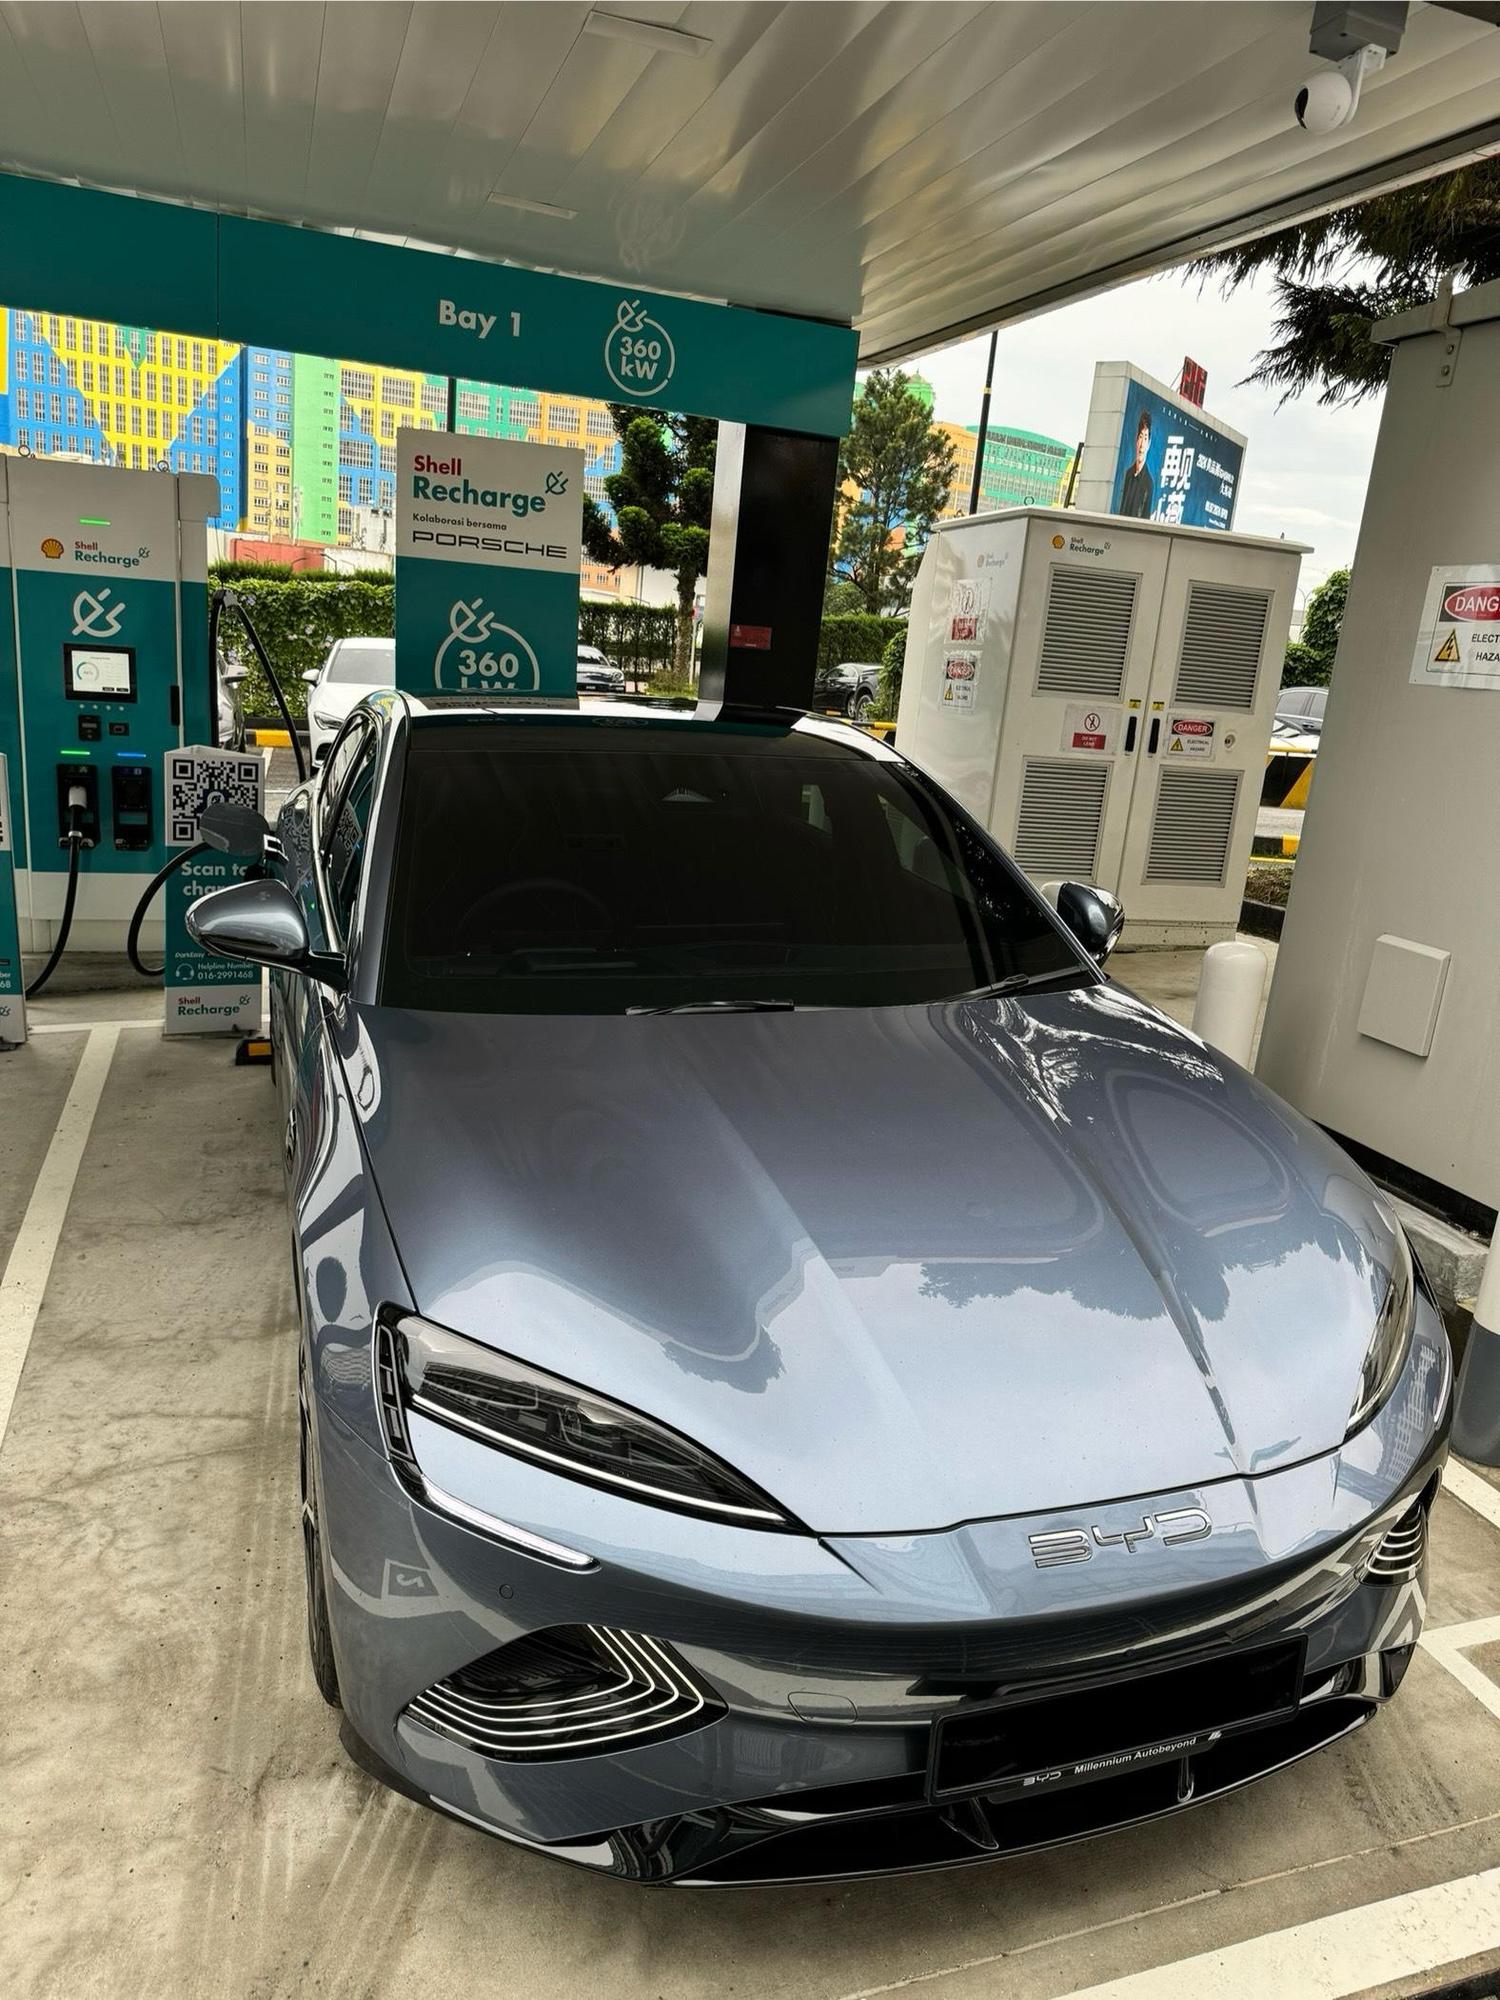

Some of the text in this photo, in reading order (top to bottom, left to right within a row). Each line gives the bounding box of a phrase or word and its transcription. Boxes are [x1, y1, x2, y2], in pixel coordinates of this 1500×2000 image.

[439, 299, 521, 339] Bay 1
[620, 336, 662, 360] 360
[620, 355, 658, 380] kW
[414, 454, 462, 476] Shell
[413, 475, 546, 518] Recharge
[412, 512, 507, 531] Kolaborasi bersama
[74, 541, 98, 551] Shell
[412, 530, 567, 559] PORSCHE
[1069, 543, 1105, 557] Recharge
[74, 550, 140, 568] Recharge
[1454, 596, 1500, 612] DANG
[1471, 633, 1500, 643] ELECT
[458, 650, 520, 679] 360
[1475, 652, 1500, 662] HAZA
[1177, 722, 1208, 733] DANGER
[181, 861, 226, 876] Scan
[197, 962, 225, 971] Helpline
[197, 970, 254, 980] 016-2991468
[178, 996, 201, 1005] Shell
[177, 1004, 240, 1016] Recharge
[1027, 1506, 1213, 1569] BYD
[1023, 1737, 1197, 1787] BYD Millennium Autobeyond
